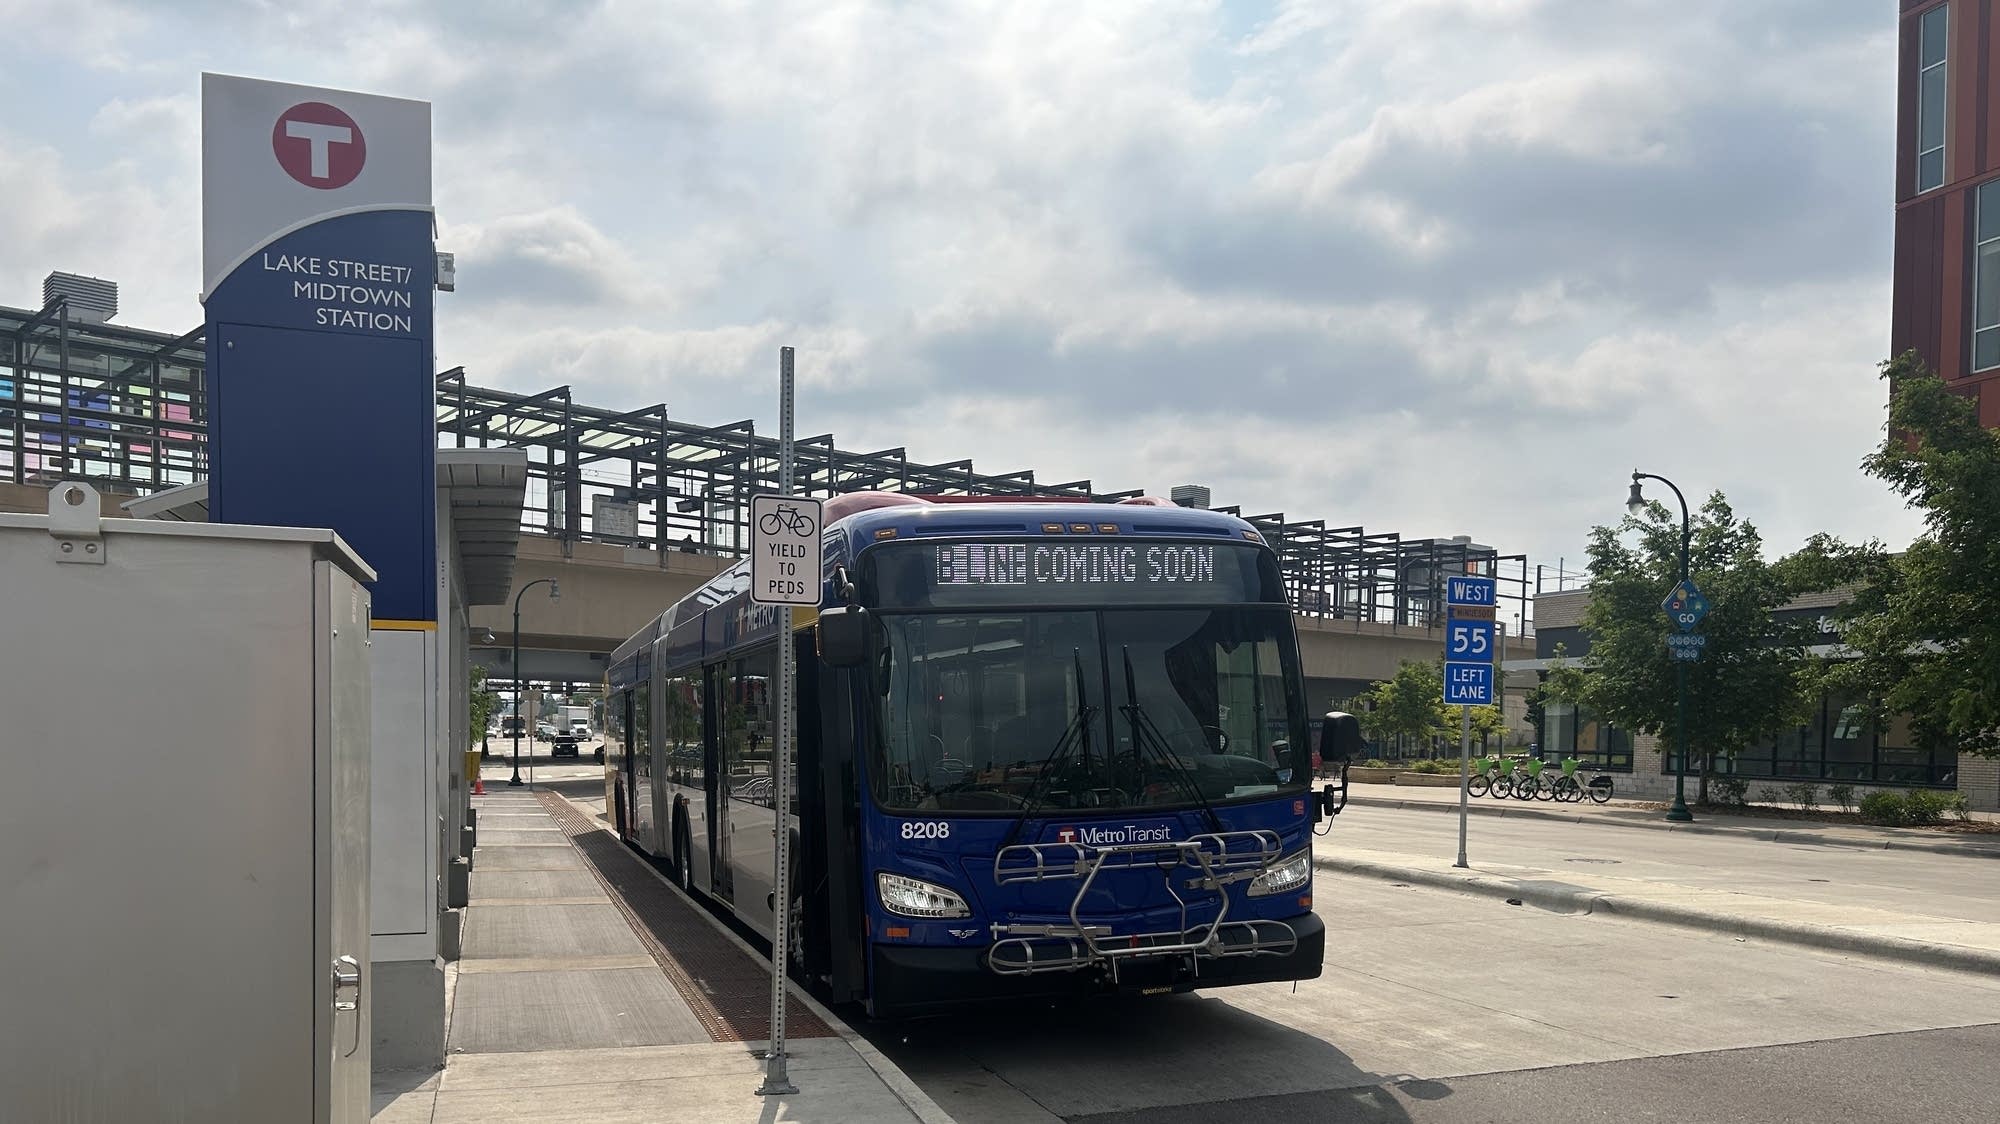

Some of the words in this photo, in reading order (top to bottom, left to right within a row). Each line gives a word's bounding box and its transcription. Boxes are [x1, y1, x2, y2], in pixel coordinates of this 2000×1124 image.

[285, 119, 352, 179] T
[264, 252, 321, 275] LAKE
[328, 259, 412, 284] STREET/
[293, 280, 411, 309] MIDTOWN
[316, 307, 411, 333] STATION
[768, 542, 806, 558] YIELD
[779, 562, 796, 576] TO
[1034, 546, 1136, 582] COMING
[1146, 546, 1213, 582] SOON
[768, 580, 805, 595] PEDS
[1454, 581, 1489, 602] WEST
[1678, 613, 1695, 623] GO
[1453, 627, 1487, 654] 55
[1453, 668, 1485, 683] LEFT
[1451, 685, 1486, 699] LANE
[901, 822, 950, 839] 8208
